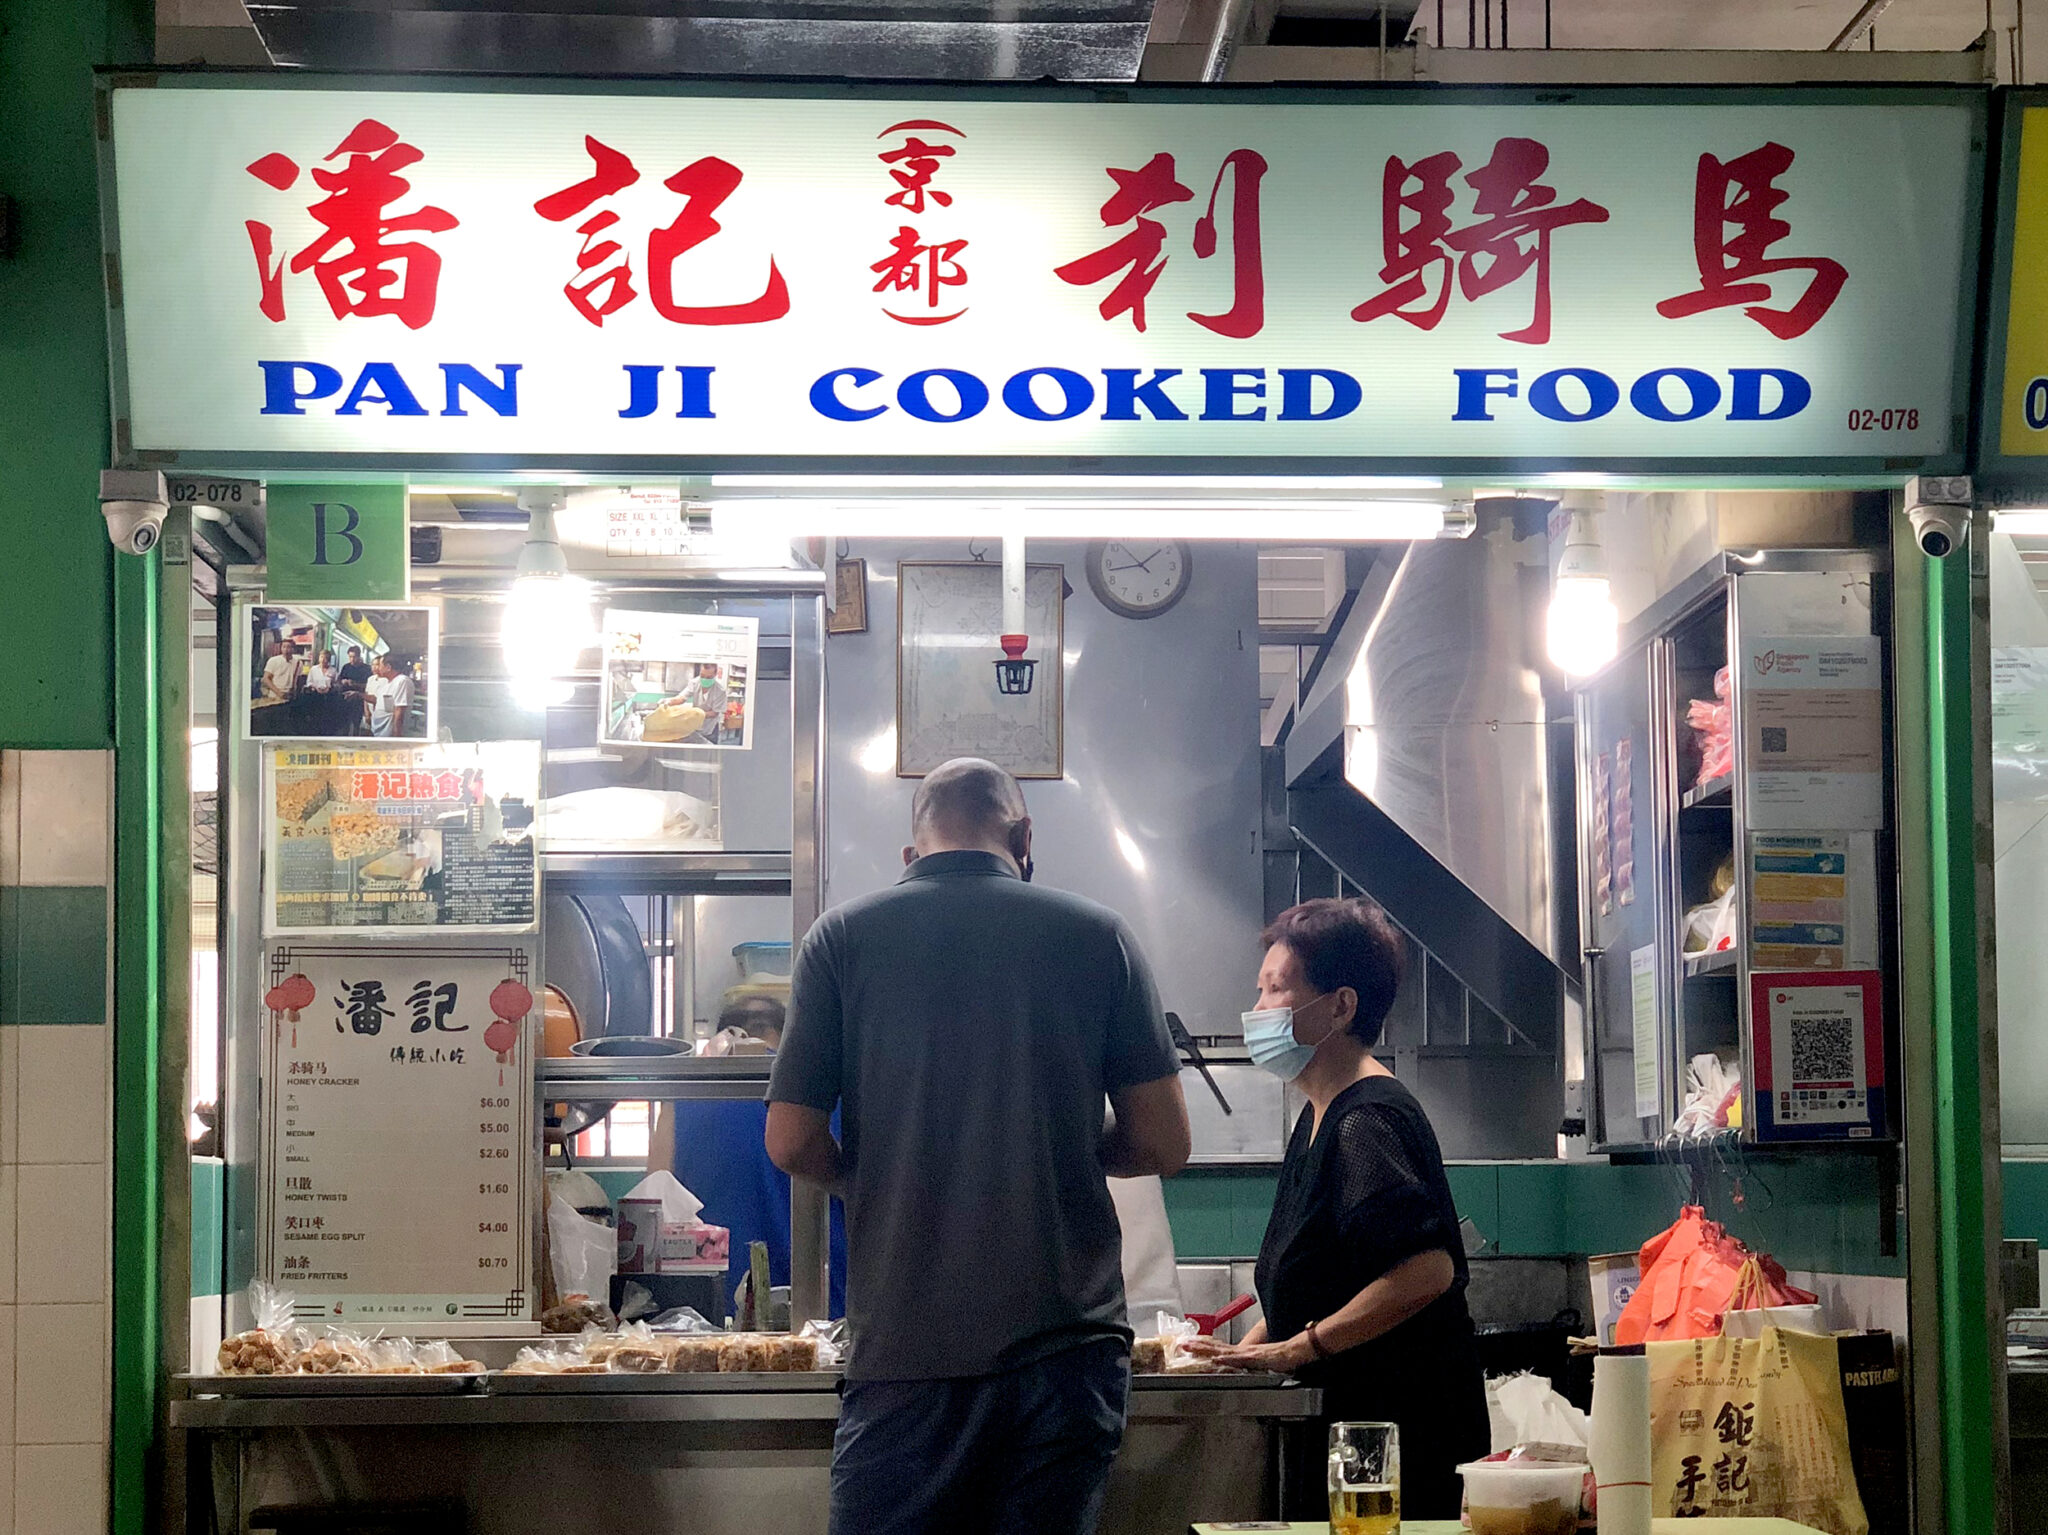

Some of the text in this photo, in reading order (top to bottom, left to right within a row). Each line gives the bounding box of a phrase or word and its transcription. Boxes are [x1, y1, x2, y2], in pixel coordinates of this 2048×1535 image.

[246, 120, 791, 331] 潘記
[260, 361, 1812, 423] PAN JI COOKED FOOD
[1848, 409, 1919, 431] 02-078
[174, 484, 242, 502] 02-078
[609, 512, 627, 522] SIZE
[633, 512, 645, 521] XXL
[650, 512, 658, 521] XL
[309, 503, 363, 565] B
[609, 528, 673, 537] QTY 6 8 10
[1110, 543, 1120, 553] 10
[1165, 545, 1172, 555] 2
[1105, 559, 1112, 569] 9
[1169, 561, 1177, 571] 3
[1109, 575, 1116, 585] 8
[1164, 577, 1171, 586] 4
[1120, 586, 1128, 596] 7
[1152, 588, 1160, 598] 5
[1136, 592, 1143, 602] 6
[352, 770, 466, 800] 潘记熟食
[334, 979, 470, 1036] 潘記
[288, 1061, 327, 1075] 杀骑马
[287, 1078, 360, 1086] HONEY CRACKER
[287, 1093, 296, 1102] 大
[480, 1098, 510, 1108] $6.00
[286, 1119, 296, 1127] 中
[480, 1123, 510, 1133] $5.00
[286, 1144, 295, 1154] 小
[479, 1148, 509, 1159] $2.60
[479, 1184, 508, 1194] $1.60
[478, 1222, 508, 1233] $4.00
[284, 1233, 366, 1241] SESAME EGG SPLIT
[478, 1257, 508, 1268] $0.70
[307, 1272, 349, 1280] FRITTERS
[1713, 1401, 1755, 1494] 鉅記
